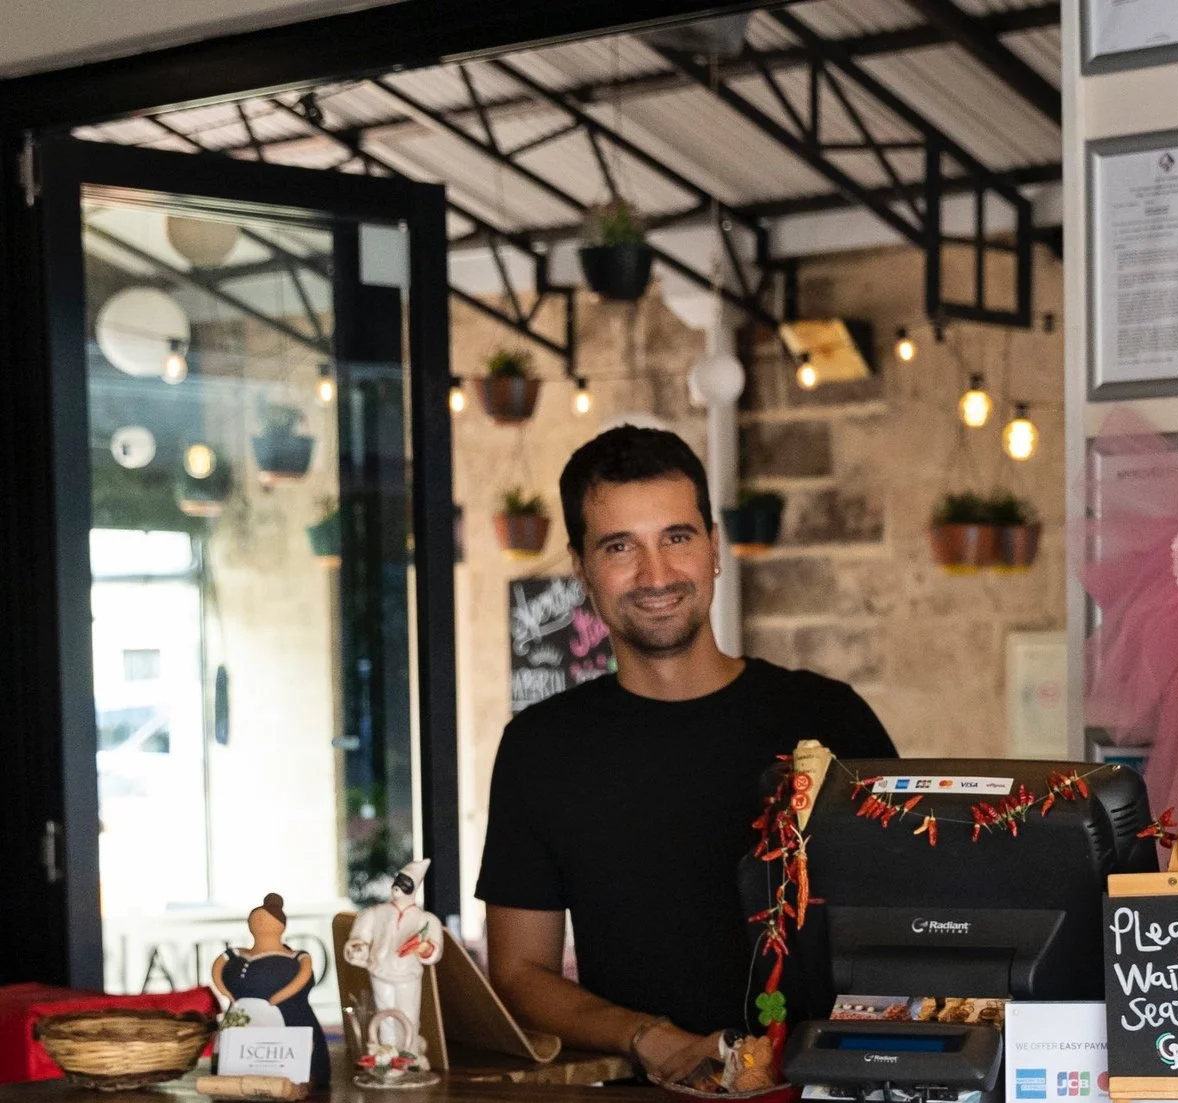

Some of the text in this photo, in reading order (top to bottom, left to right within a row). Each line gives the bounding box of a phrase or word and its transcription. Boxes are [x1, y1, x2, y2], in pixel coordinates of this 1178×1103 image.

[929, 920, 969, 930] Radiant
[1016, 1042, 1108, 1050] WE OFFER EASY PAYM
[240, 1043, 295, 1060] ISCHIA
